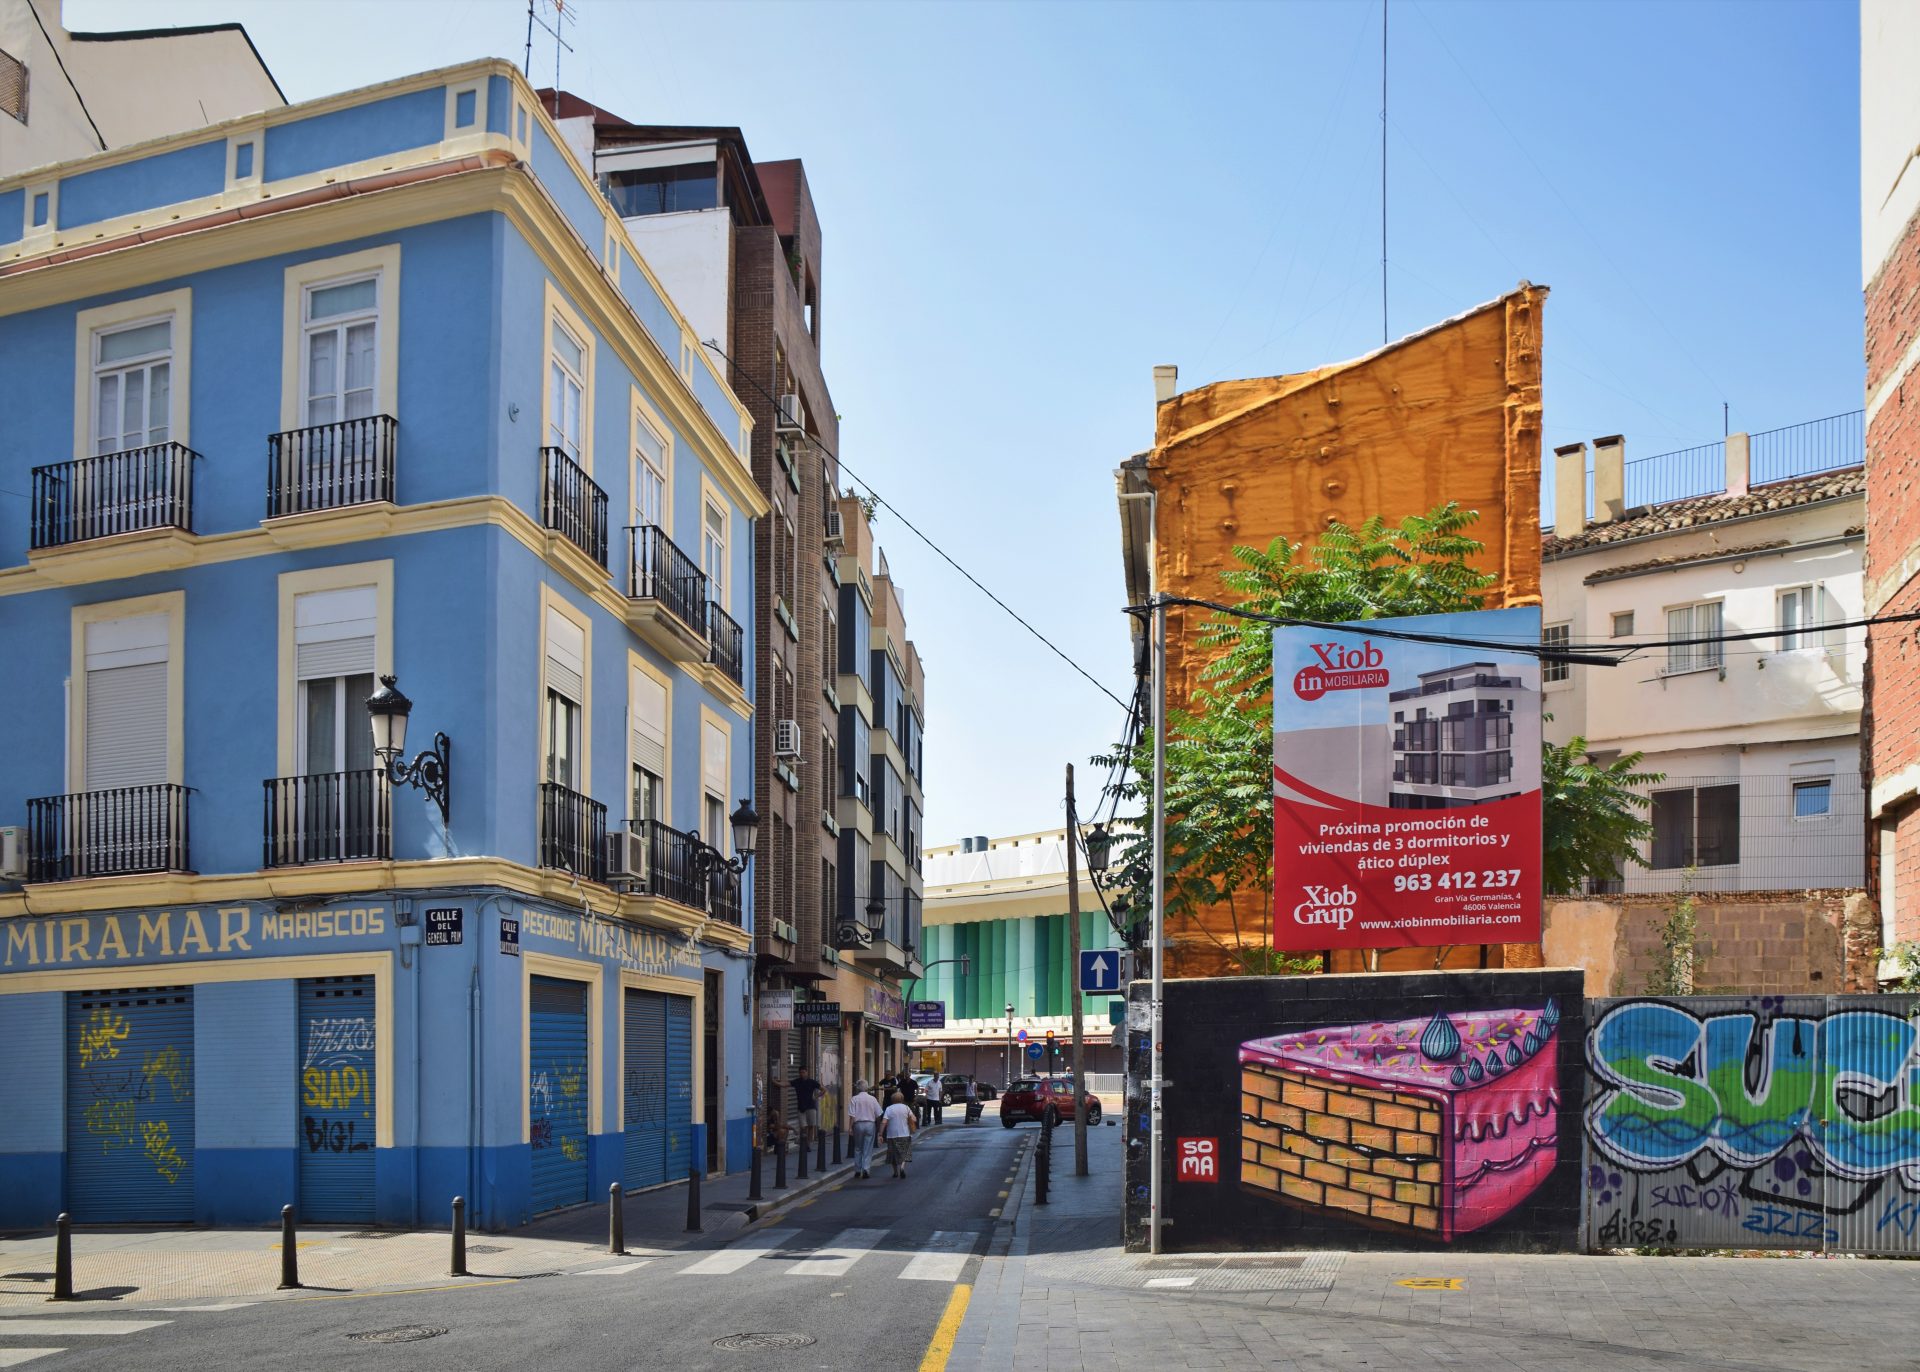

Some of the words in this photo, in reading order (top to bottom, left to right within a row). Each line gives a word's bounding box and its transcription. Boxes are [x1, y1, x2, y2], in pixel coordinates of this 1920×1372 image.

[1310, 640, 1384, 670] Xiob
[1319, 822, 1381, 836] Próxima
[1385, 816, 1466, 835] promoción
[1470, 815, 1489, 828] de
[1299, 838, 1369, 855] viviendas
[1373, 837, 1391, 851] de
[1395, 838, 1404, 850] 3
[1407, 833, 1497, 849] dormitorios
[1500, 834, 1510, 847] y
[1357, 855, 1394, 870] ático
[1398, 853, 1450, 870] dúplex
[1393, 873, 1432, 892] 963
[1437, 871, 1477, 890] 412
[1482, 869, 1521, 888] 237
[1302, 884, 1357, 907] Xiob
[1434, 895, 1454, 903] Gran
[1456, 894, 1468, 902] Vía
[1469, 893, 1514, 902] Germanías,
[430, 910, 458, 922] CALLE
[1293, 900, 1354, 930] Grup
[1463, 903, 1486, 911] 46006
[1488, 902, 1521, 910] Valencia
[437, 922, 452, 930] DEL
[502, 921, 517, 933] CALLE
[1360, 914, 1521, 930] www.xiobinmobiliaria.com
[4, 908, 252, 966] MIRAMAR
[262, 908, 384, 940] MARISCOS
[427, 931, 449, 944] GENERAL
[523, 909, 576, 943] PESCADOS
[578, 915, 667, 964] MIRAMAR
